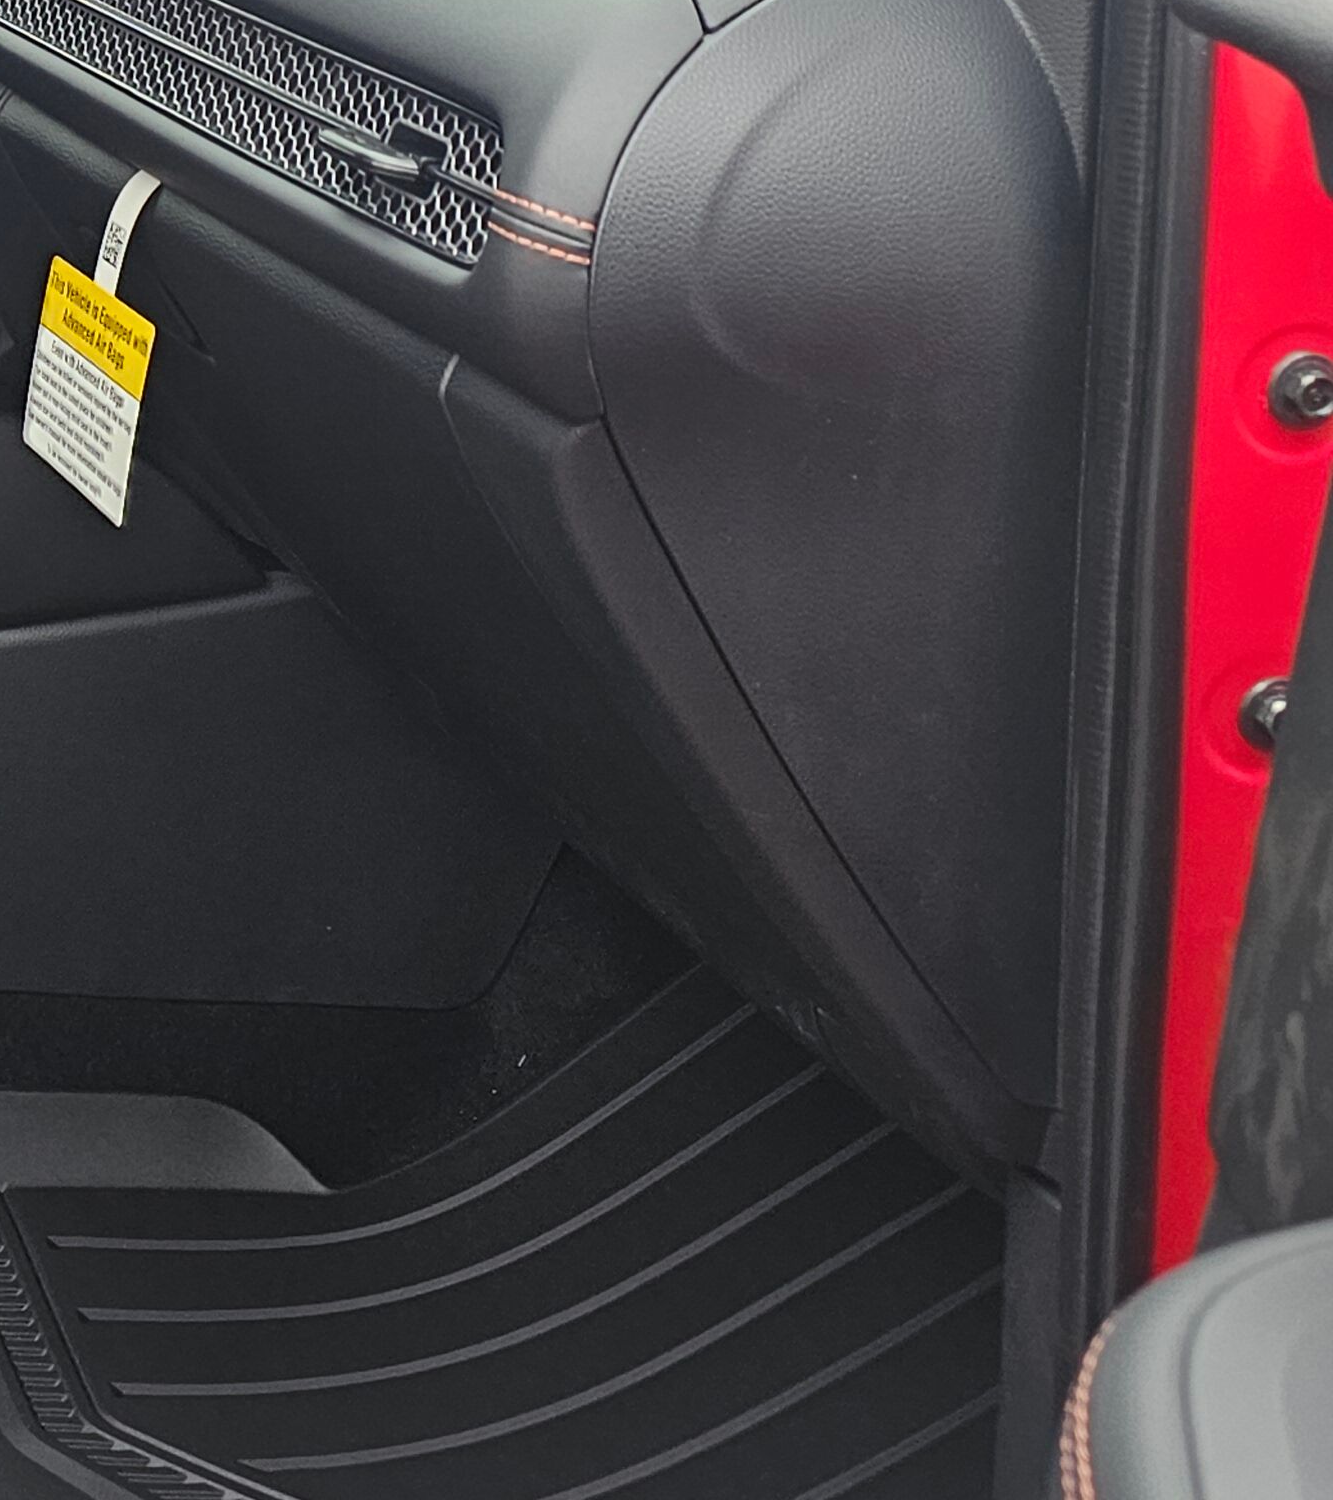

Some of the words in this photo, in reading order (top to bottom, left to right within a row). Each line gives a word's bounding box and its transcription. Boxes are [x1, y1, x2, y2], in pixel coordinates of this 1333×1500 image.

[51, 270, 65, 295] This
[66, 281, 91, 314] Vehicle
[99, 305, 133, 346] Equipped
[133, 334, 148, 358] with
[62, 308, 95, 346] Advanced
[95, 333, 107, 355] Air
[106, 341, 125, 370] Bags
[76, 359, 101, 390] Advanced
